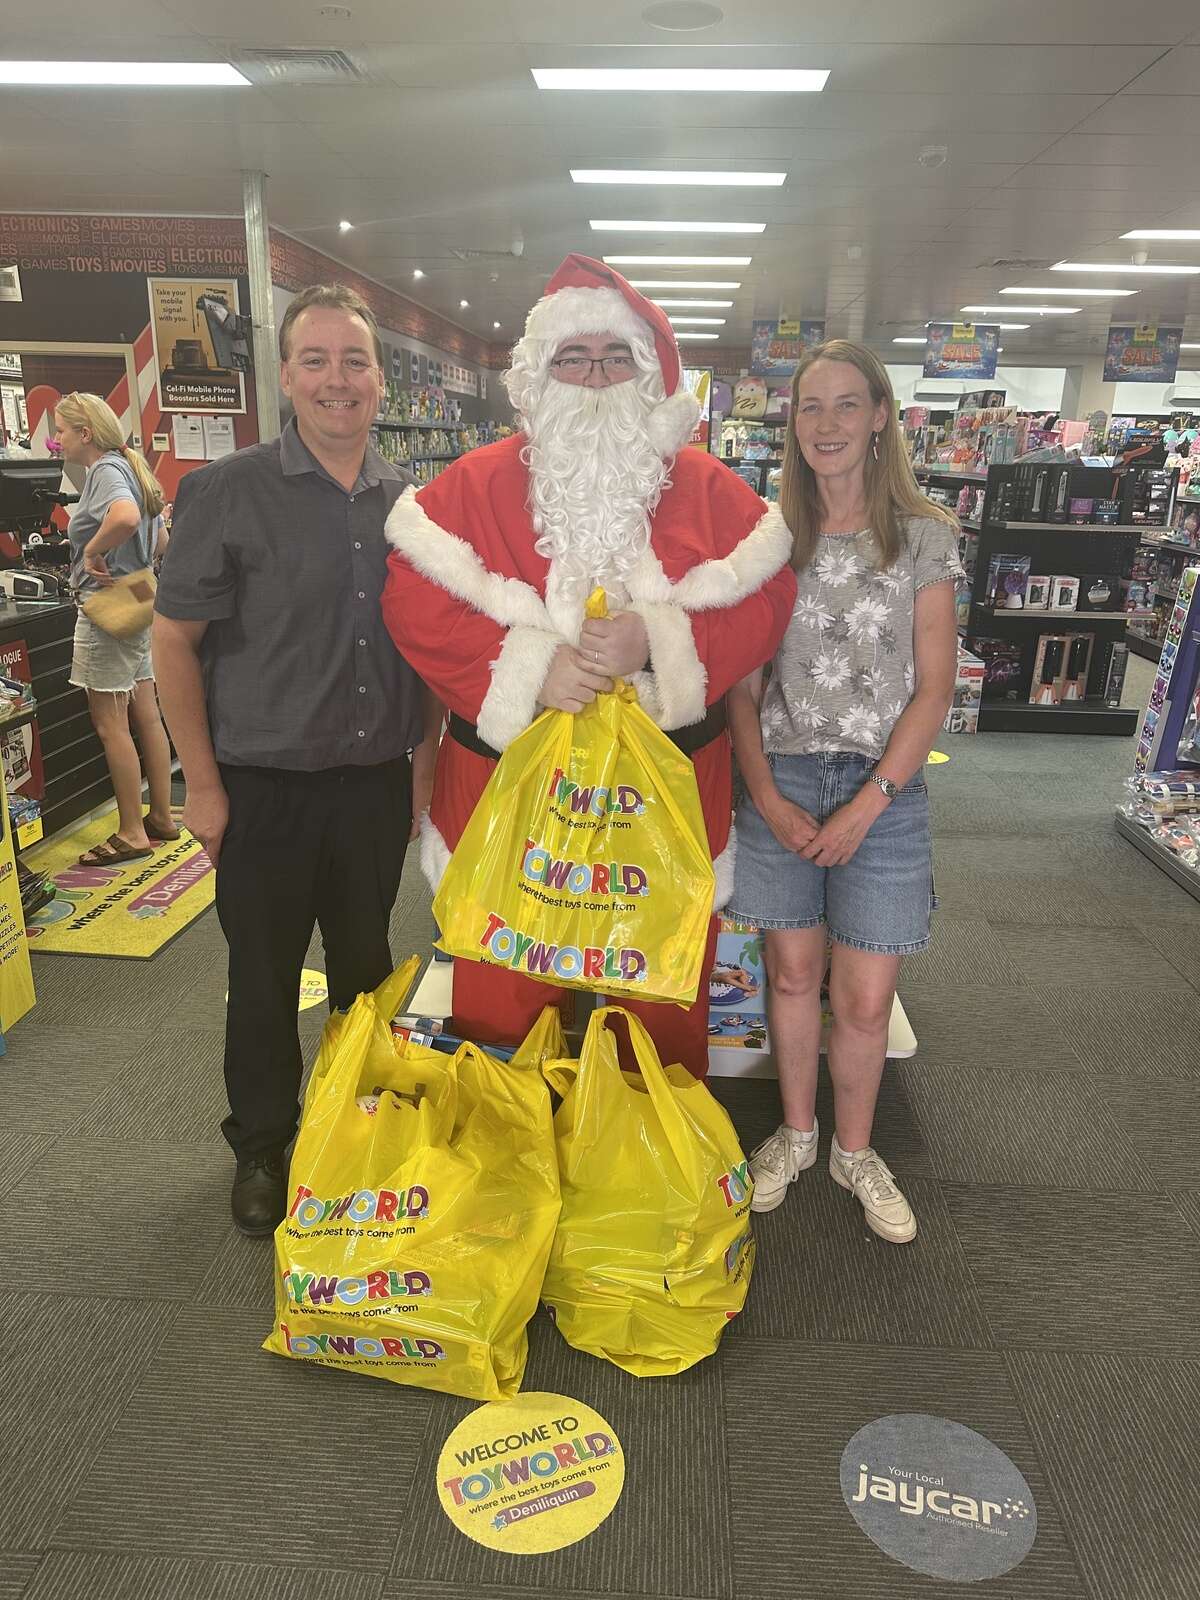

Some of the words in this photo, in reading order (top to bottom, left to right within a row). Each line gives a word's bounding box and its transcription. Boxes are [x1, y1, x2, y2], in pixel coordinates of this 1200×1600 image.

[90, 217, 140, 231] GAMES
[141, 218, 195, 232] MOVIES
[41, 233, 81, 244] MOVIES
[91, 231, 196, 247] ELECTRONICS
[20, 258, 68, 271] GAMES
[67, 256, 102, 273] TOYS
[110, 259, 168, 274] MOVIES
[156, 288, 171, 296] Take
[172, 290, 186, 298] your
[160, 297, 183, 305] mobile
[159, 314, 173, 322] with
[162, 306, 183, 316] signal
[1122, 346, 1162, 366] SALE
[166, 384, 186, 394] Cel-Fi
[187, 385, 212, 395] Mobile
[213, 386, 236, 395] Phone
[169, 394, 199, 404] Boosters
[200, 394, 216, 404] Sold
[217, 395, 235, 404] Here
[0, 649, 22, 665] OGUE
[66, 902, 113, 931] where
[103, 886, 134, 902] the
[122, 867, 158, 888] best
[150, 852, 180, 870] toys
[583, 900, 610, 912] come
[611, 901, 636, 912] from
[480, 911, 647, 982] TOYWORLD
[287, 1184, 429, 1228] TOYWORLD
[324, 1227, 344, 1236] best
[346, 1227, 365, 1238] toys
[367, 1230, 394, 1238] come
[363, 1306, 391, 1317] come
[280, 1323, 446, 1360] TOYWORLD
[454, 1424, 552, 1468] WELCOME
[551, 1415, 579, 1436] TO
[443, 1431, 616, 1508] TOYWORLD
[887, 1465, 914, 1480] Your
[914, 1470, 945, 1487] Local
[468, 1499, 499, 1515] where
[500, 1491, 517, 1505] the
[517, 1484, 540, 1498] best
[539, 1479, 561, 1493] toys
[561, 1470, 588, 1483] come
[587, 1461, 611, 1475] from
[851, 1462, 1003, 1526] jaycar
[508, 1486, 580, 1520] Deniliquin
[925, 1510, 975, 1530] Authorised
[974, 1522, 1010, 1538] Reseller
